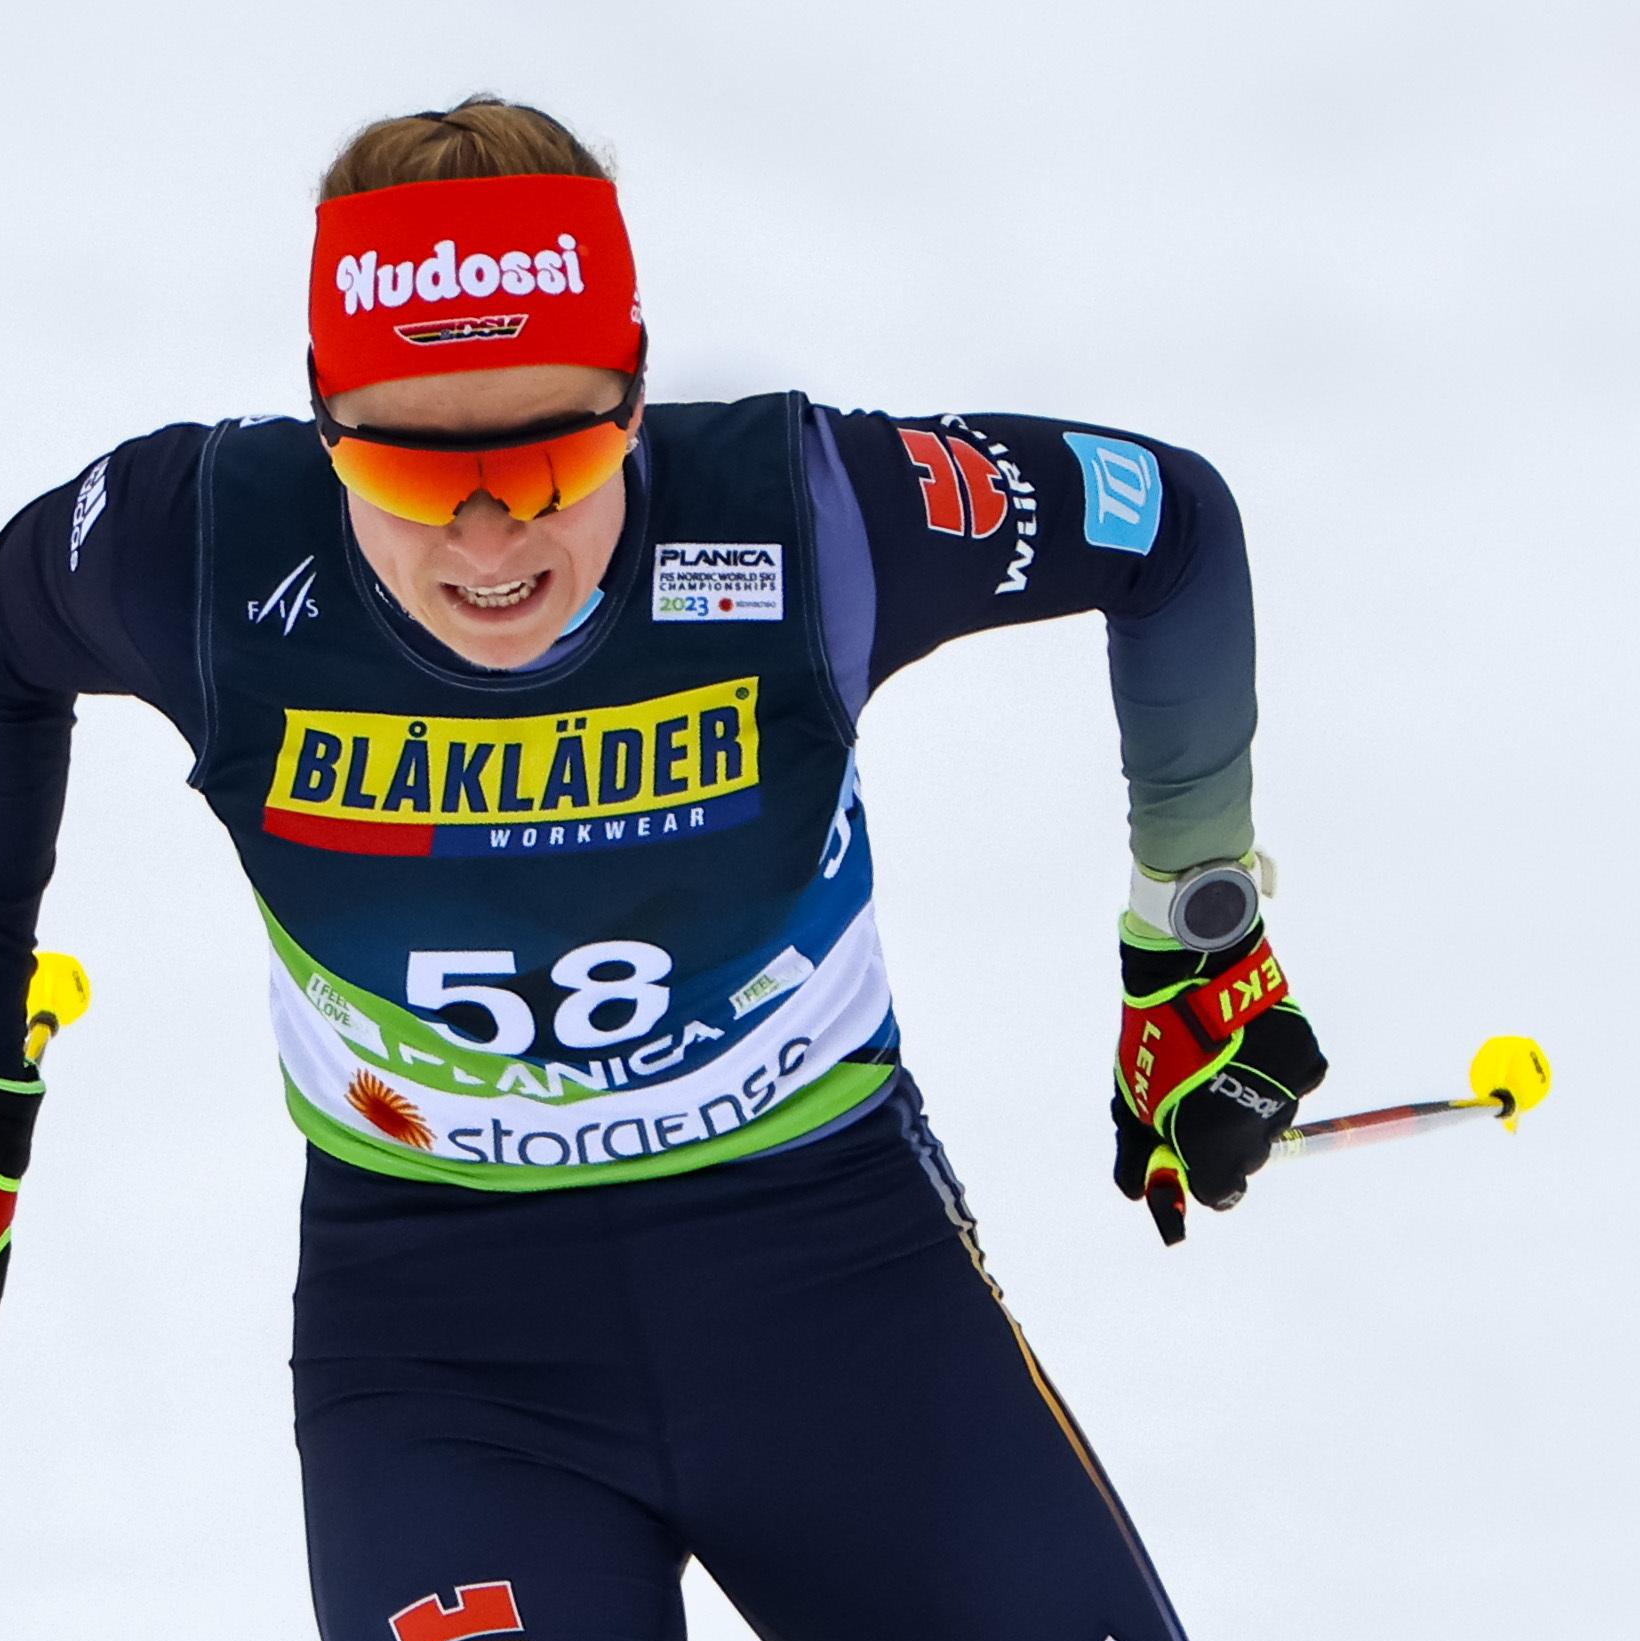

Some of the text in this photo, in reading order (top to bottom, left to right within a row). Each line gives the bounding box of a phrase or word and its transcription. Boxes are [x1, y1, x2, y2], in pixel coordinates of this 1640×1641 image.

[336, 233, 585, 316] Nudossi
[660, 549, 775, 567] PLANICA
[660, 582, 777, 592] CHAMPIONSHIPS
[677, 572, 717, 582] NORDIC
[718, 572, 757, 582] WORLD
[759, 572, 777, 582] SKI
[660, 596, 709, 617] 2023
[290, 704, 743, 814] BLÅKLÄDER
[489, 807, 706, 850] WORKWEAR
[405, 939, 674, 1057] 58
[1134, 1020, 1162, 1115] LEKI
[447, 1036, 813, 1167] storaenso
